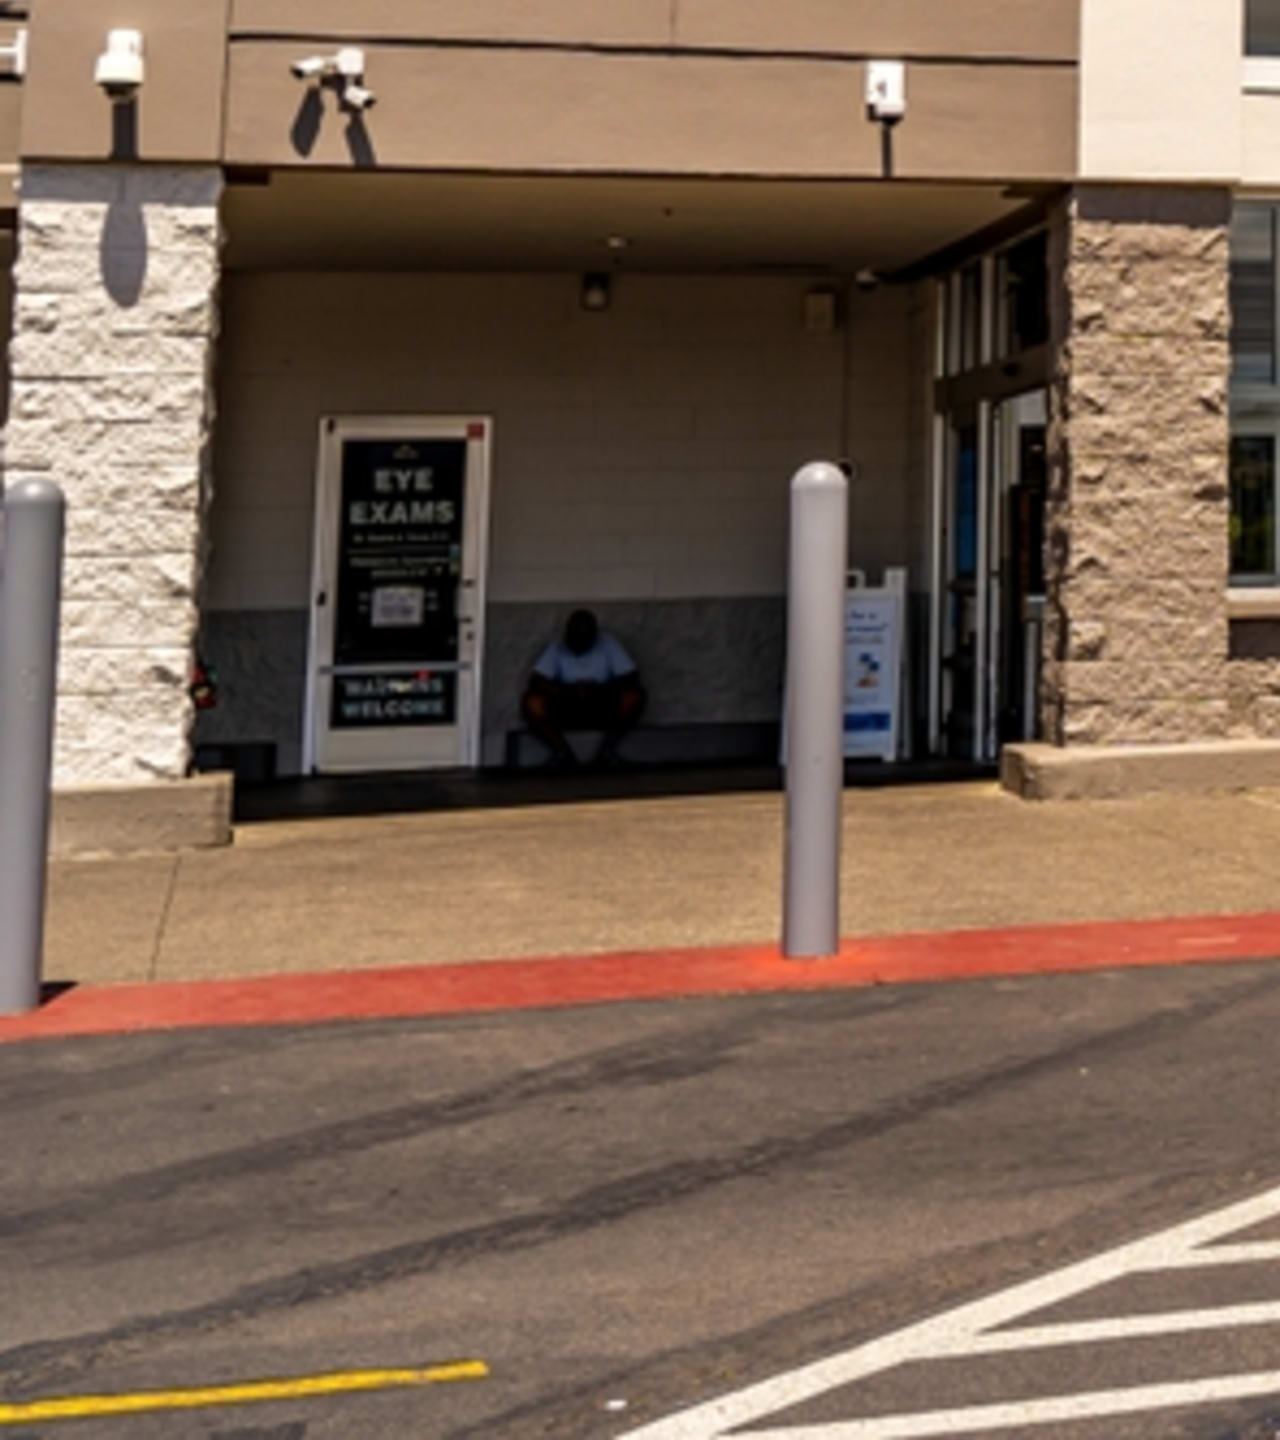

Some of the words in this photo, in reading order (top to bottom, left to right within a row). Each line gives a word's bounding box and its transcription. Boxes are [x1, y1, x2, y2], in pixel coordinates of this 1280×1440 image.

[373, 467, 434, 492] EYE
[348, 500, 455, 525] EXAMS
[341, 699, 445, 719] WELCOME
